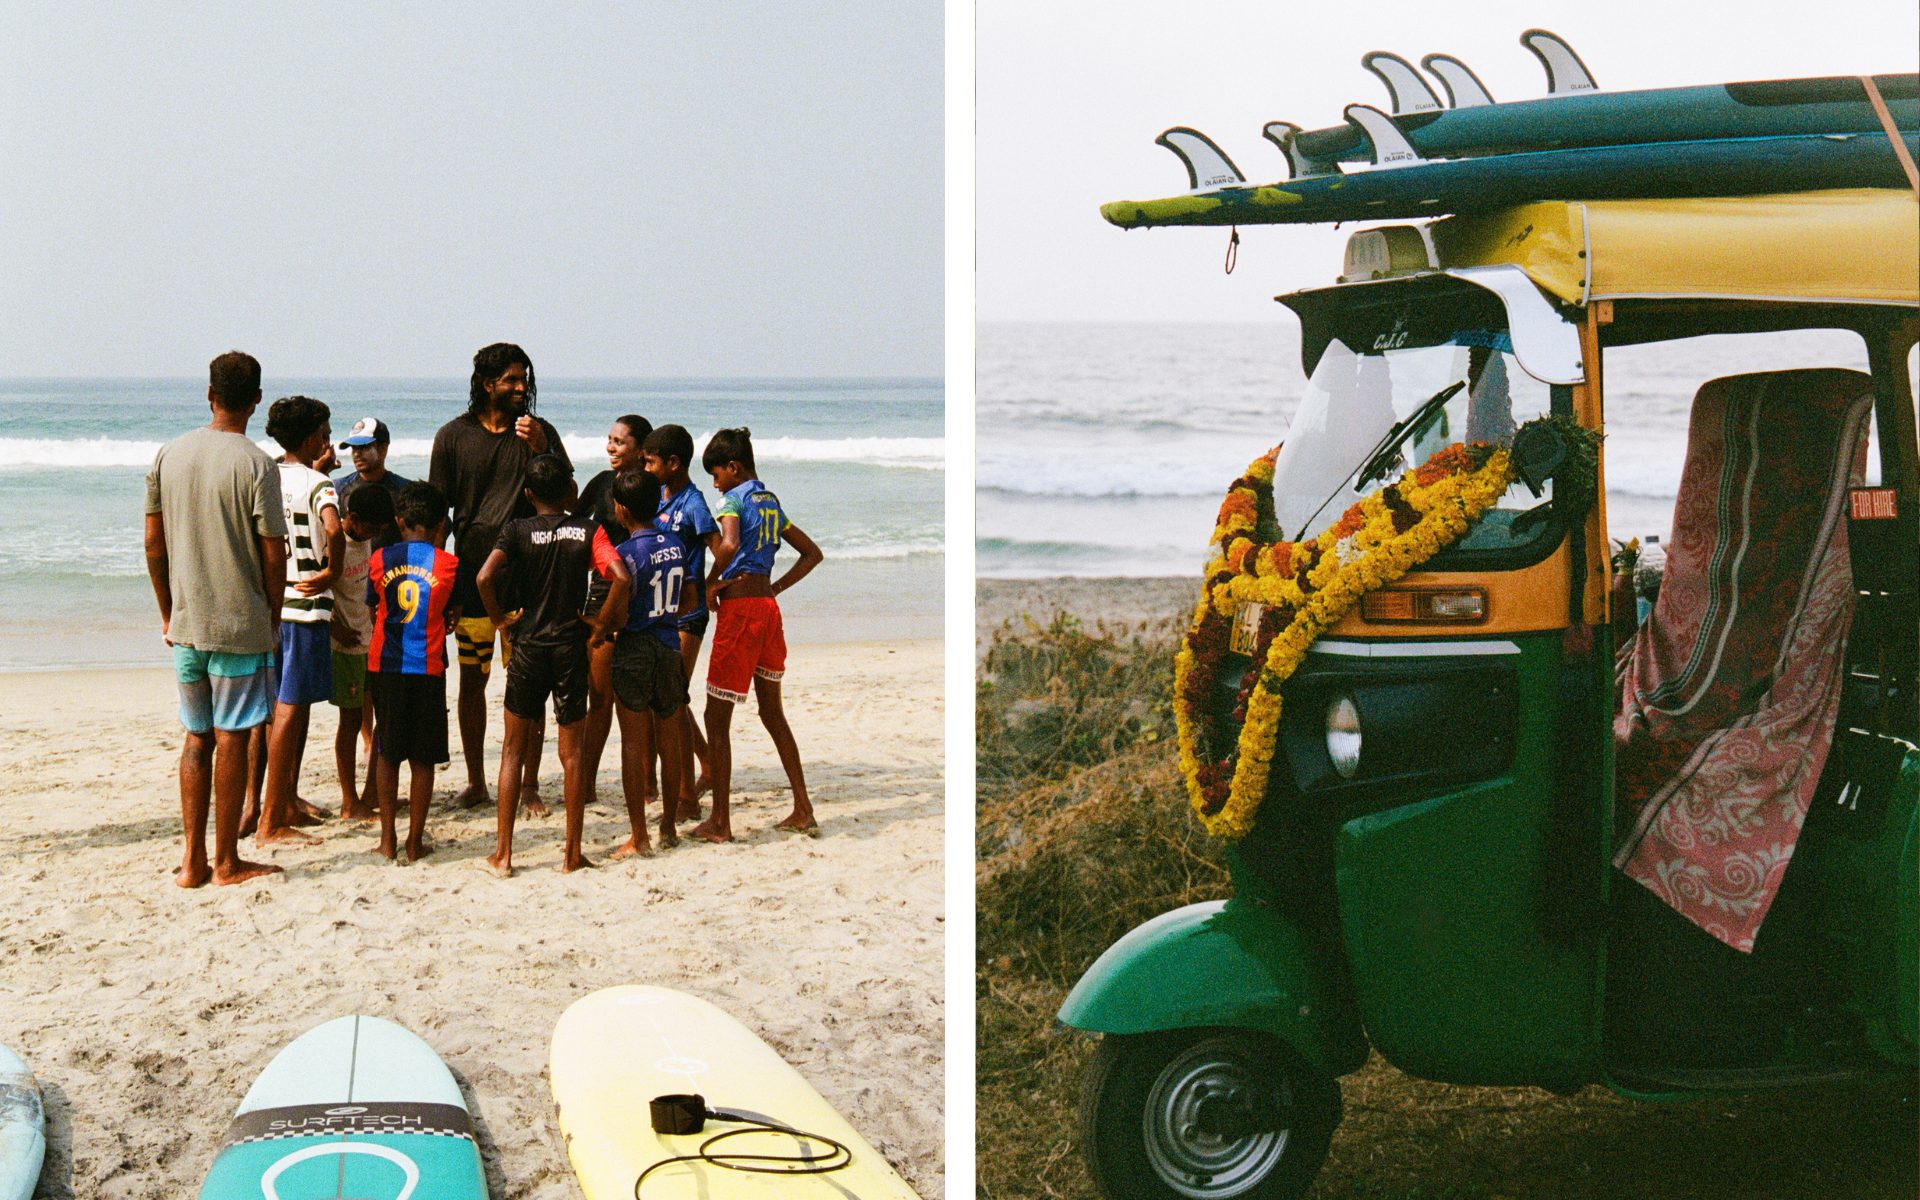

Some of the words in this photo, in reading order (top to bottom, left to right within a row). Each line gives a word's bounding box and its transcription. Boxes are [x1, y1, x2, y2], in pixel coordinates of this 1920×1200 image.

[1384, 154, 1406, 163] OLAIAN
[1205, 178, 1227, 186] OLAIAN
[1852, 491, 1872, 518] FOR
[1872, 490, 1896, 518] HIRE
[531, 530, 553, 545] NIGHT
[649, 546, 683, 566] MESSI
[648, 566, 684, 618] 10
[397, 580, 419, 624] 9
[269, 1115, 421, 1130] SURFTECH
